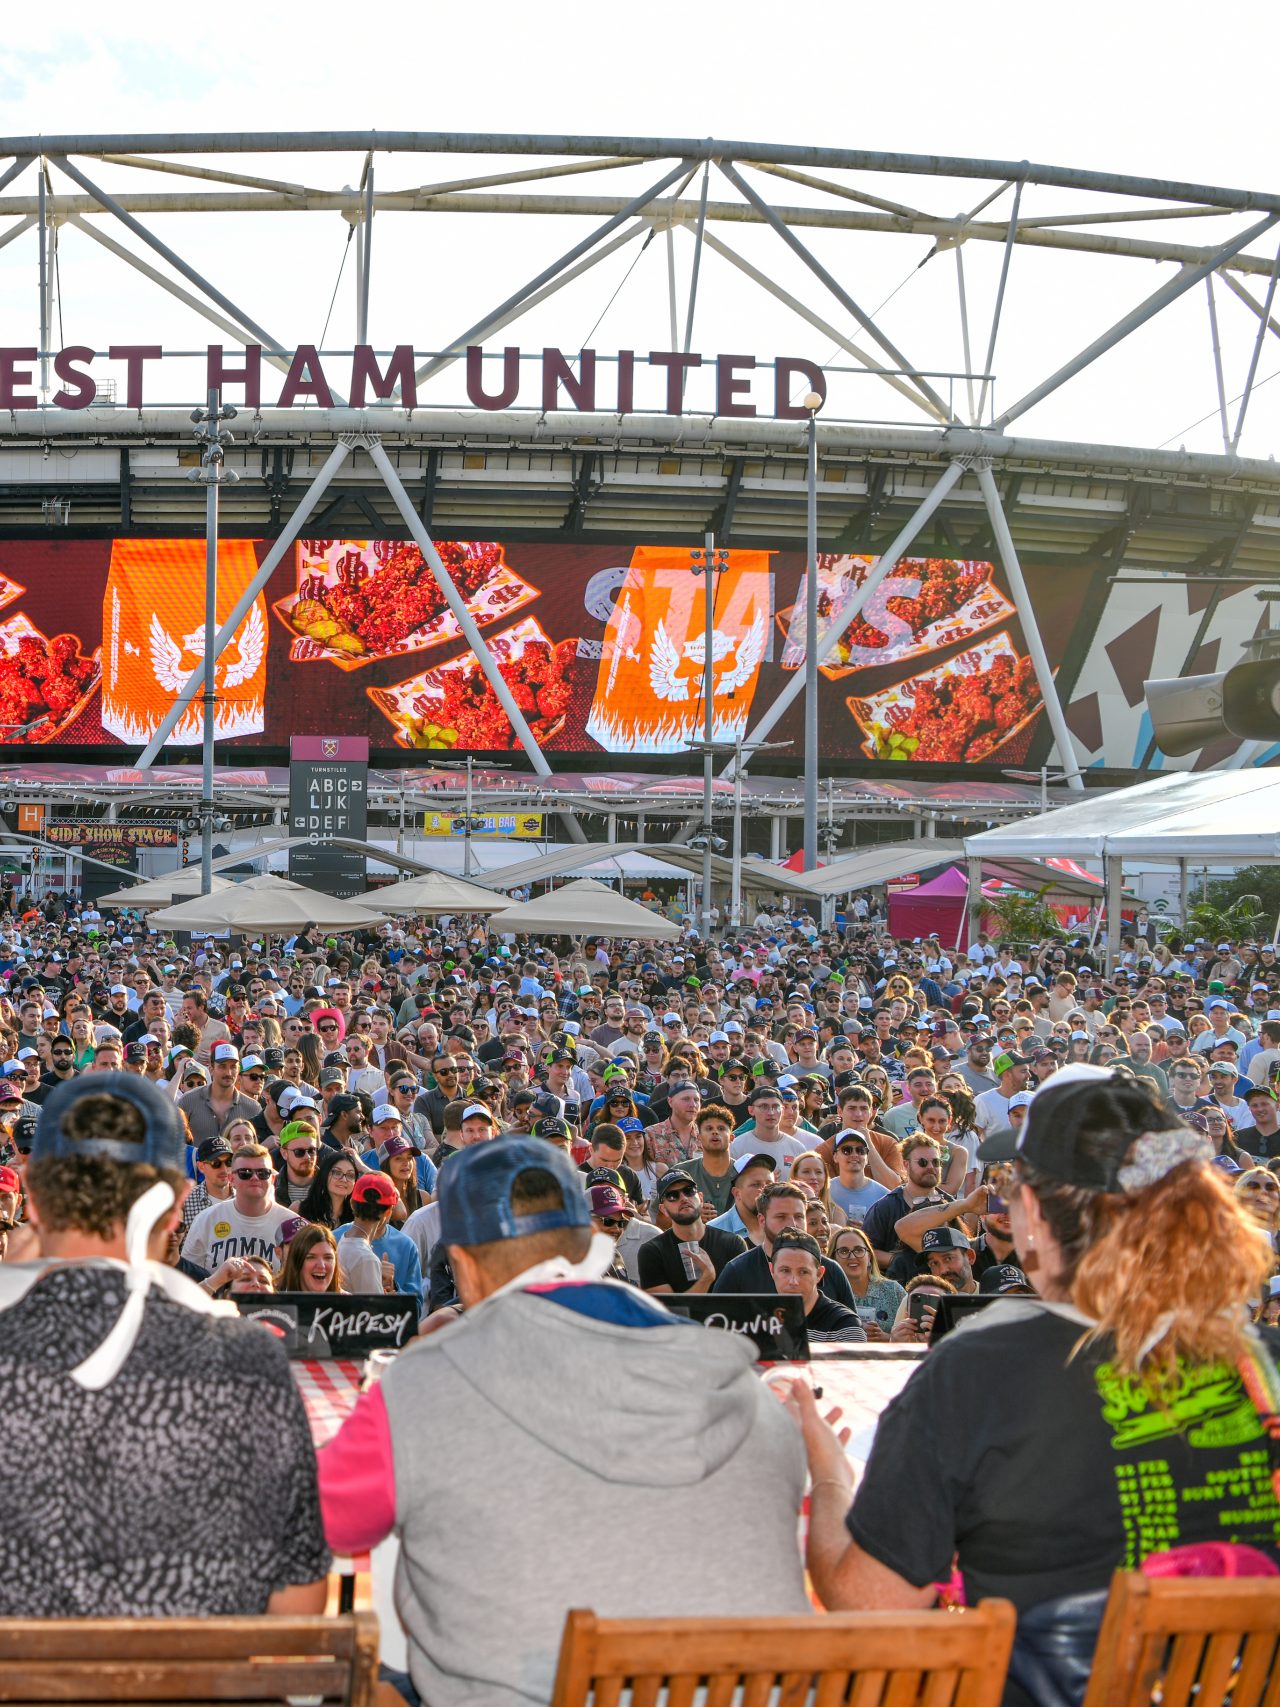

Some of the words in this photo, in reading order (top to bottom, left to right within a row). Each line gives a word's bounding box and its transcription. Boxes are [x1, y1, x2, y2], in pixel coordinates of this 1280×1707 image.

[207, 345, 415, 412] HAM
[466, 346, 827, 421] UNITED
[309, 778, 320, 793] A
[324, 778, 333, 793] B
[337, 778, 347, 793] C
[310, 795, 319, 809] L
[325, 795, 331, 809] J
[337, 795, 347, 809] K
[25, 807, 37, 822] H
[498, 815, 516, 828] BAR
[310, 816, 319, 830] D
[324, 816, 332, 830] E
[338, 816, 346, 830] F
[50, 826, 81, 842] SIDE
[85, 827, 124, 843] SHOW
[128, 827, 172, 844] STAGE
[211, 1236, 275, 1268] TOMM
